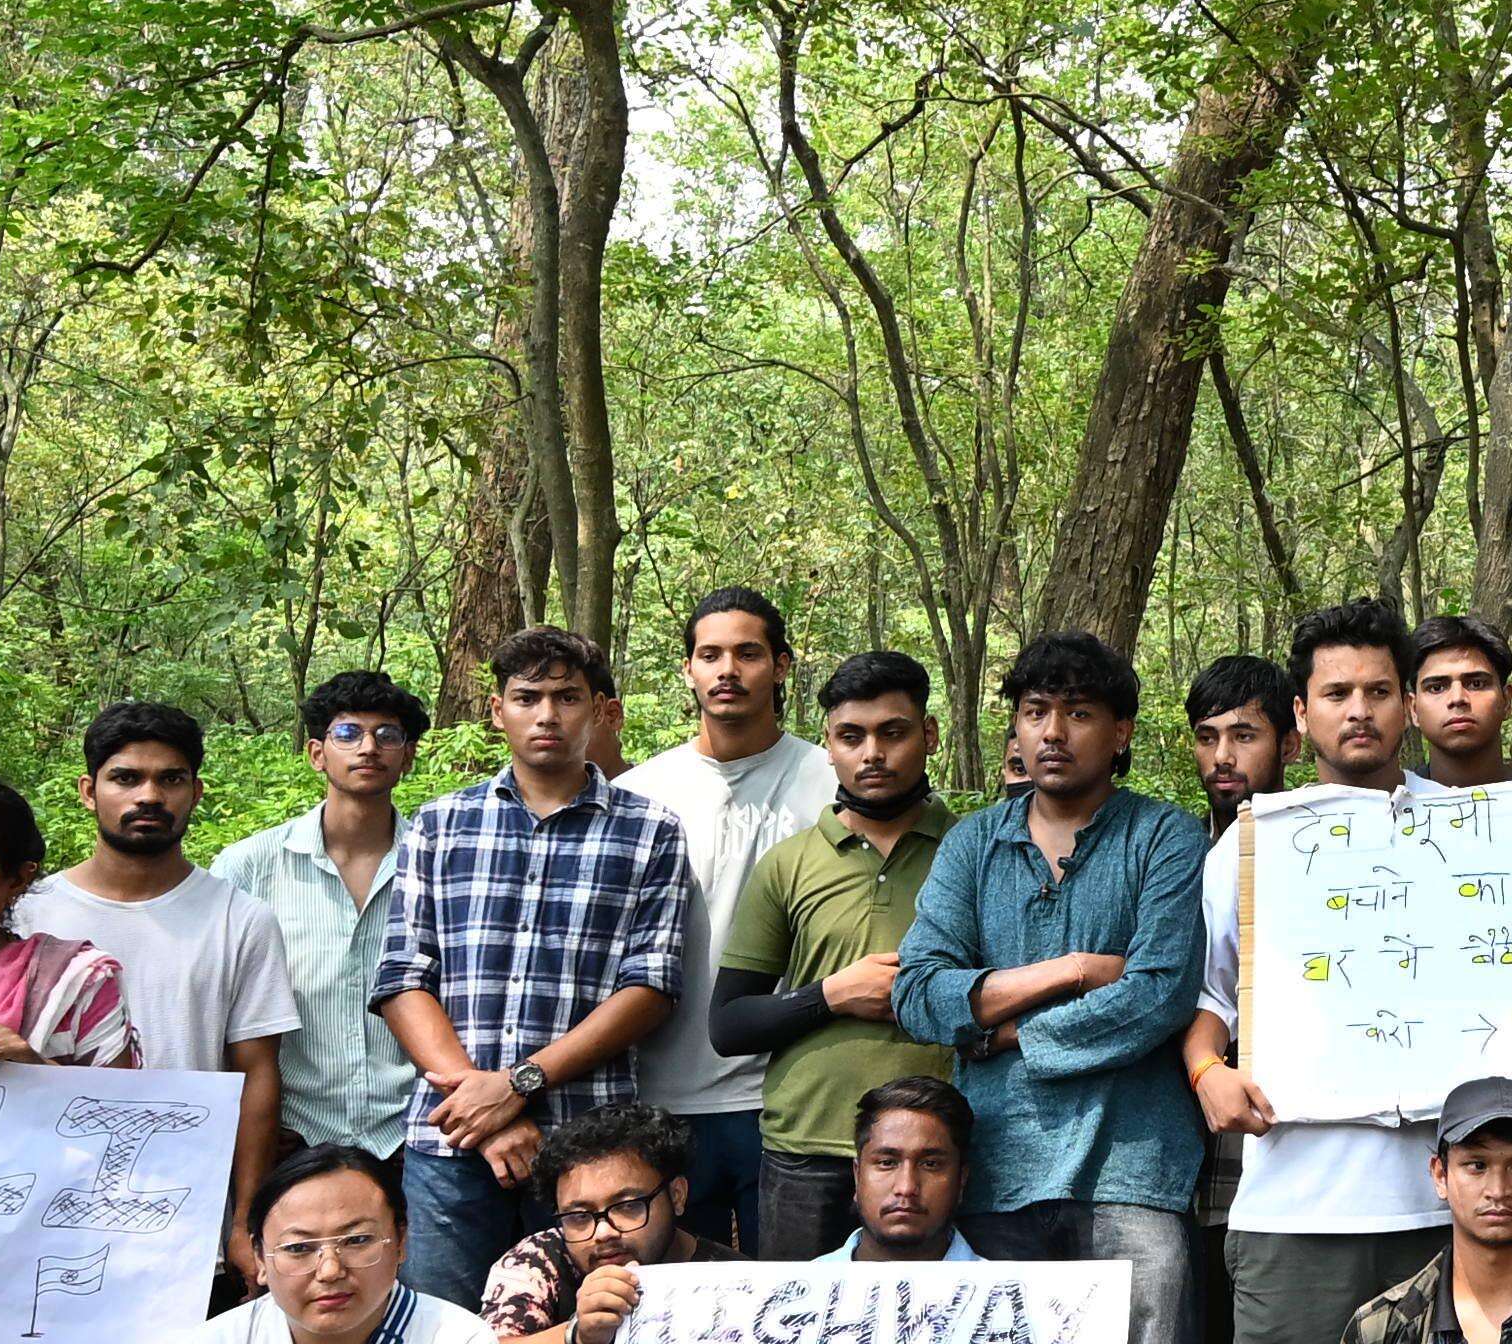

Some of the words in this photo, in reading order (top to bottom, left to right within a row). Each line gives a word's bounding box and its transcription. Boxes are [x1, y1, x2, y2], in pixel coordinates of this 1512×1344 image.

[1292, 805, 1356, 874] देव
[1451, 872, 1510, 905] का
[1301, 949, 1356, 988] घर
[1378, 933, 1434, 980] में
